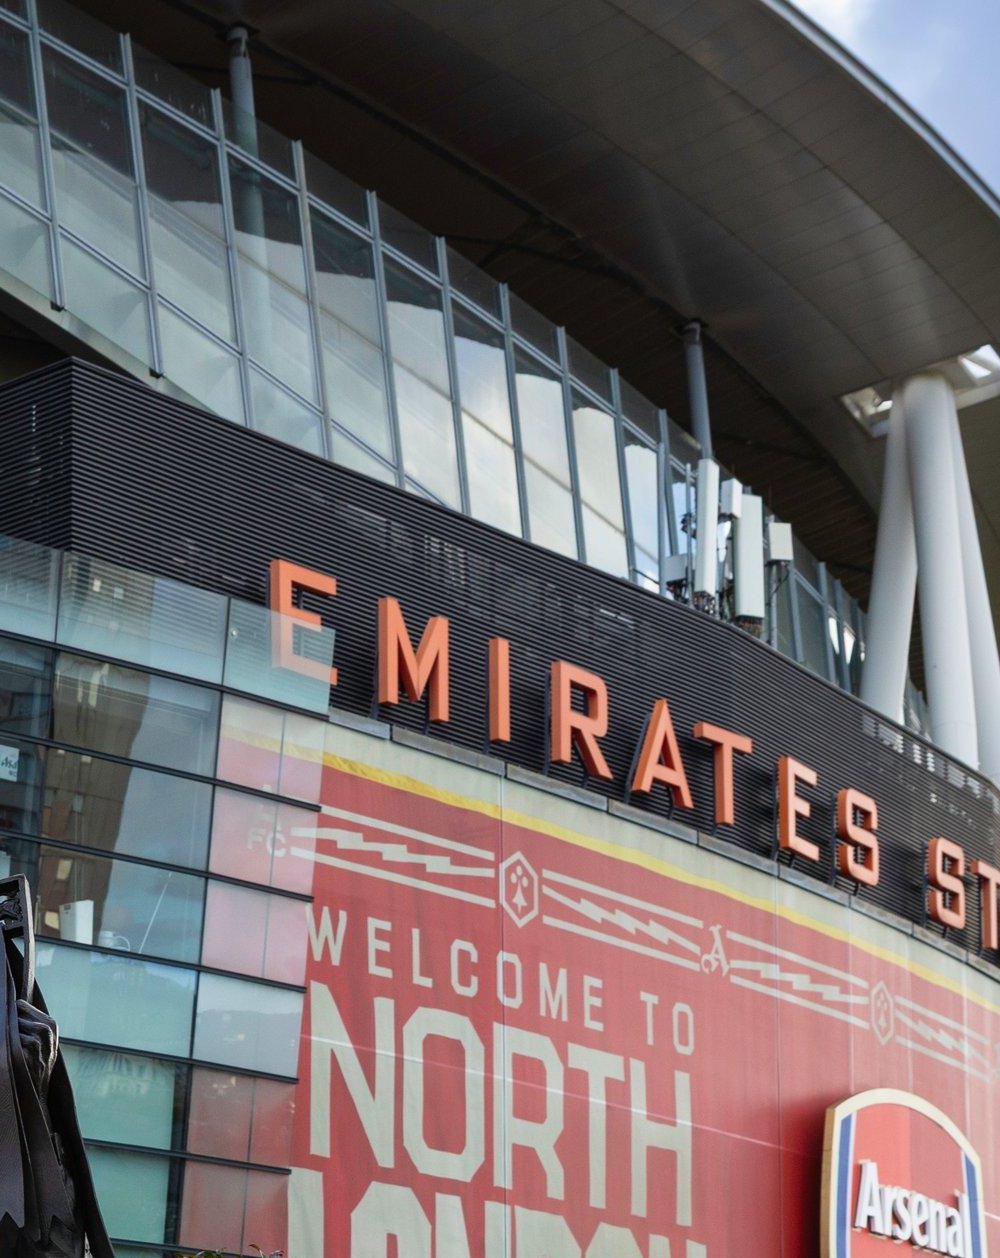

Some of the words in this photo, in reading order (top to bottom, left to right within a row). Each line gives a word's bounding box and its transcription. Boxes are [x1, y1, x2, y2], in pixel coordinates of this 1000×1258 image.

[269, 558, 880, 887] EMIRATES
[306, 905, 604, 1032] WELCOME
[640, 991, 695, 1056] TO
[309, 980, 692, 1227] NORTH
